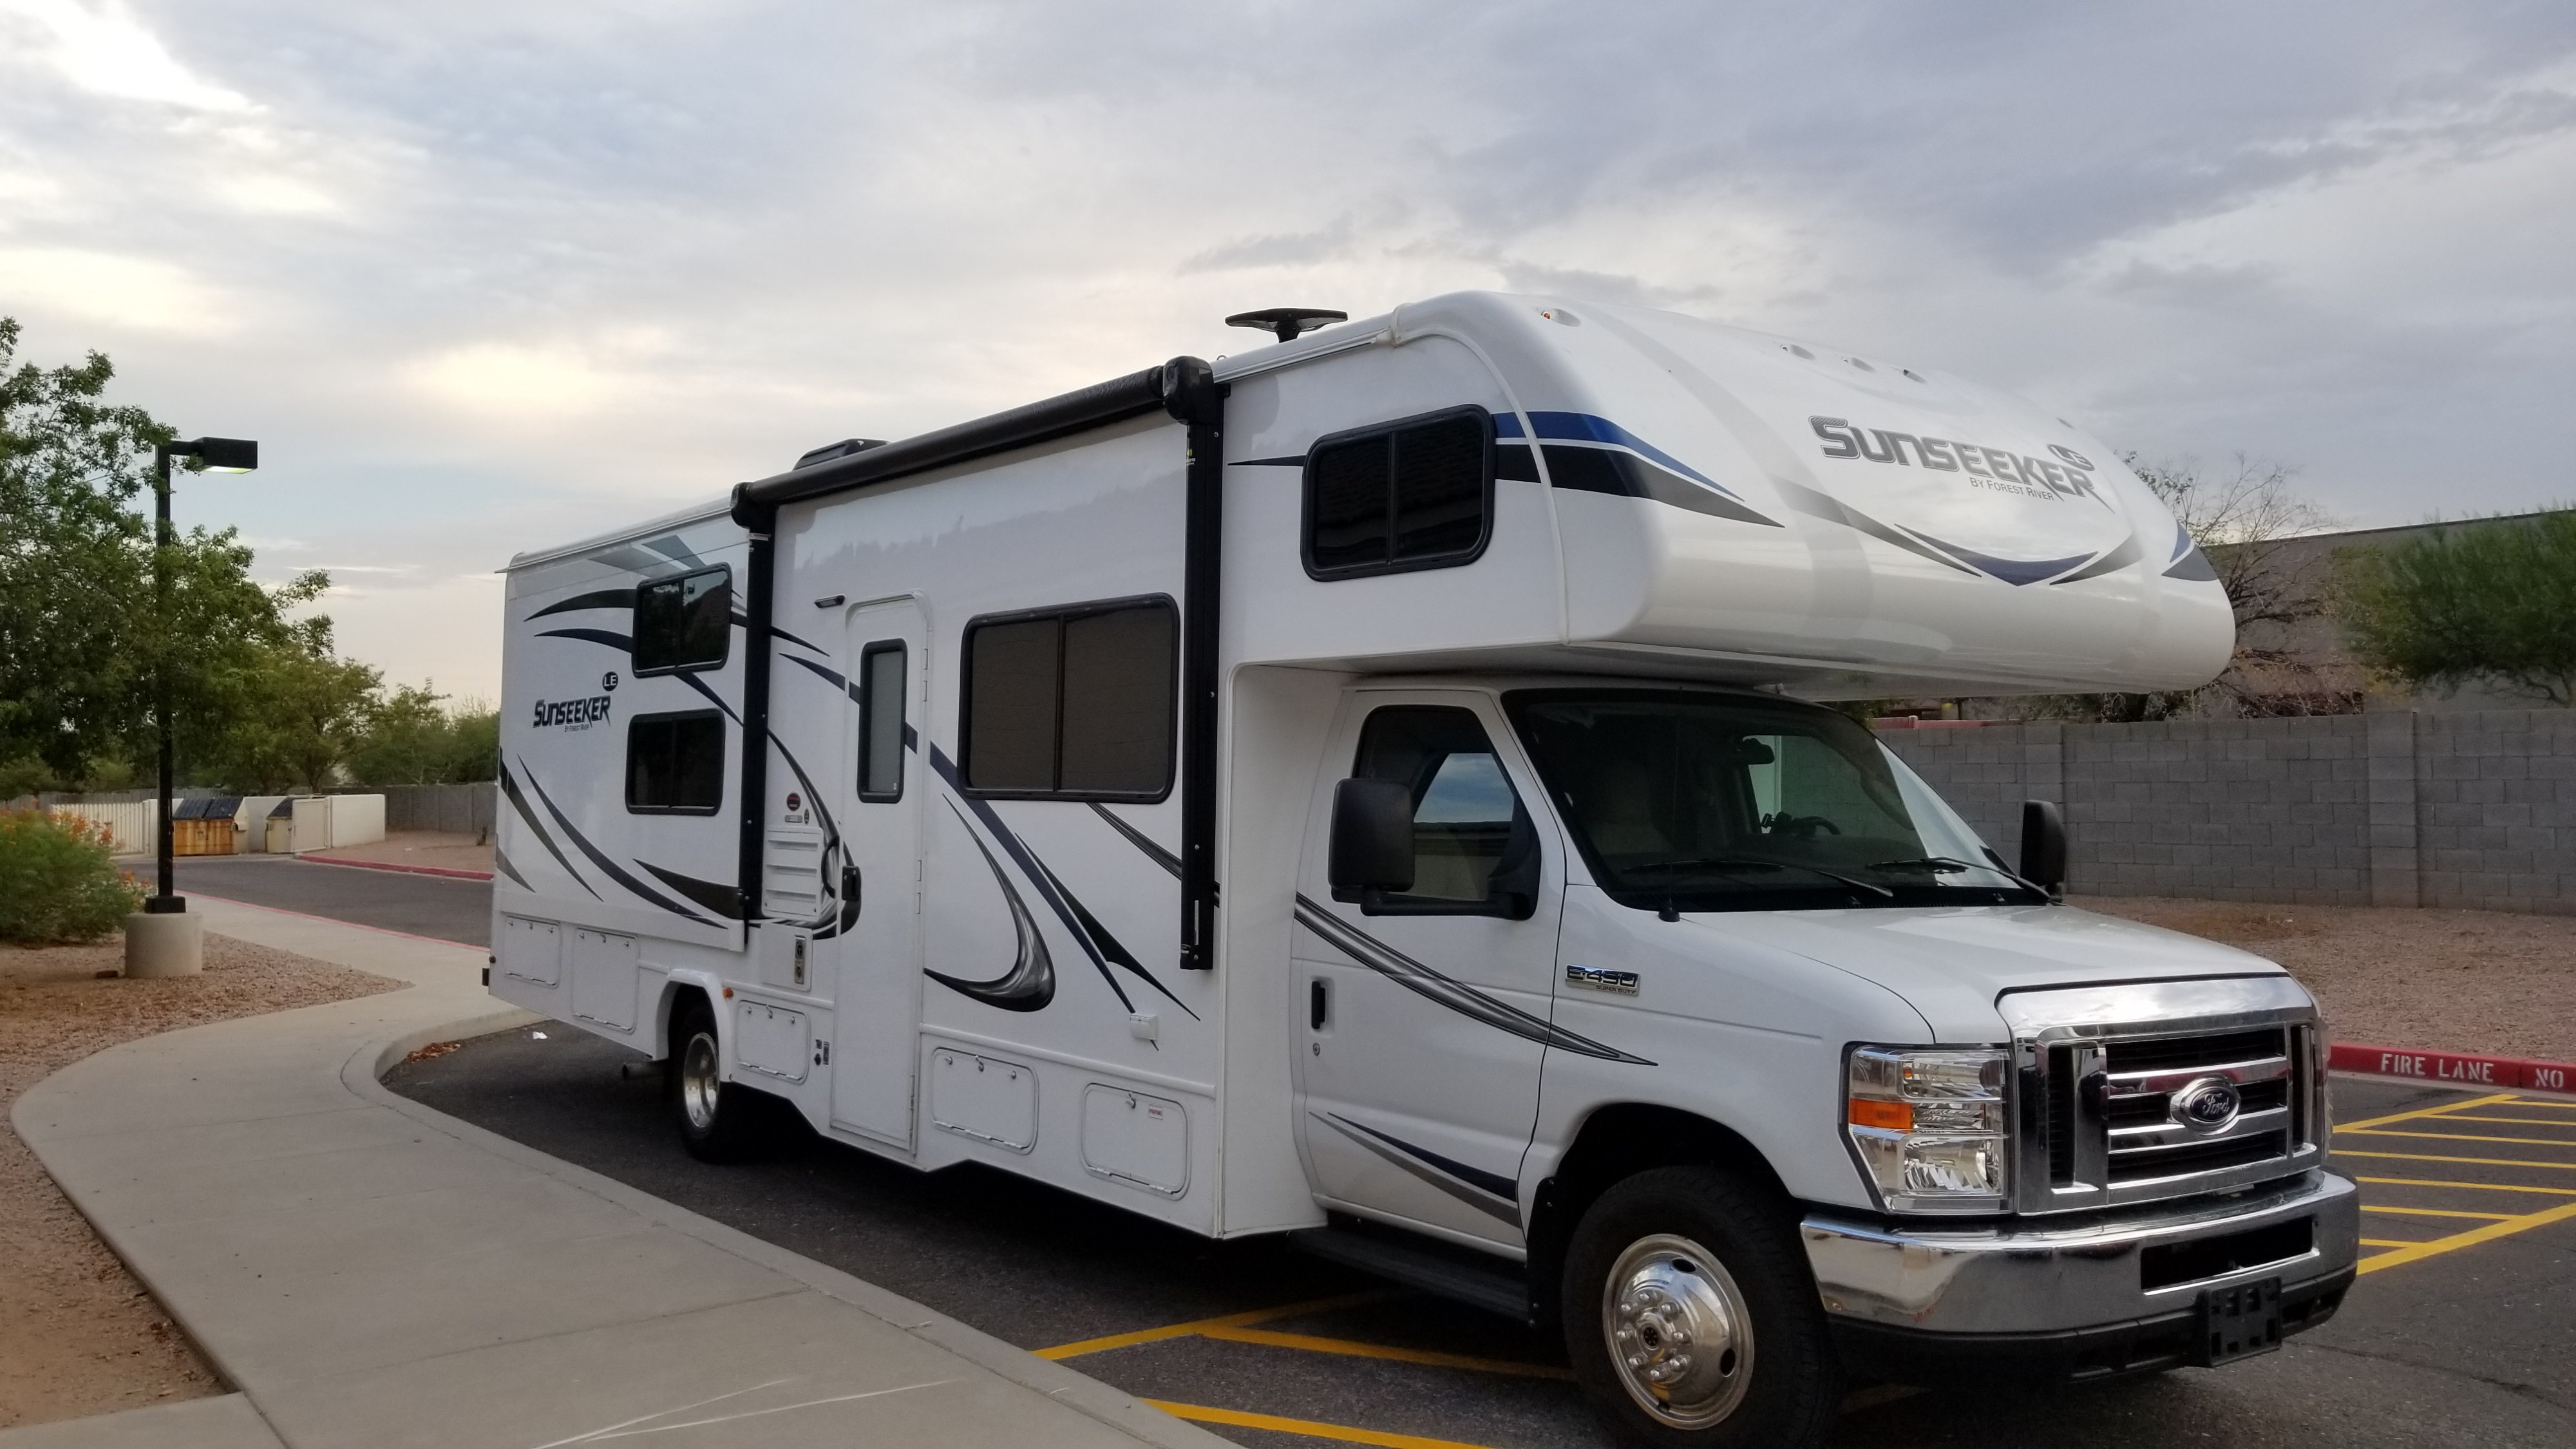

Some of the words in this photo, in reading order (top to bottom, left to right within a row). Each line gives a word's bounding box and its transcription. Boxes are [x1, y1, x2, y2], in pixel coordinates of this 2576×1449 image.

[1808, 415, 2115, 513] SUNSEEKER
[1969, 477, 1984, 488] BY
[1987, 480, 2024, 495] FOREST
[2026, 487, 2055, 501] RIVER
[604, 675, 616, 687] LE
[533, 696, 611, 728] SUNSEEKER
[2381, 1053, 2425, 1075] FIRE
[2438, 1058, 2494, 1083] LANE
[2535, 1068, 2564, 1088] NO
[2202, 1093, 2230, 1114] Ford
